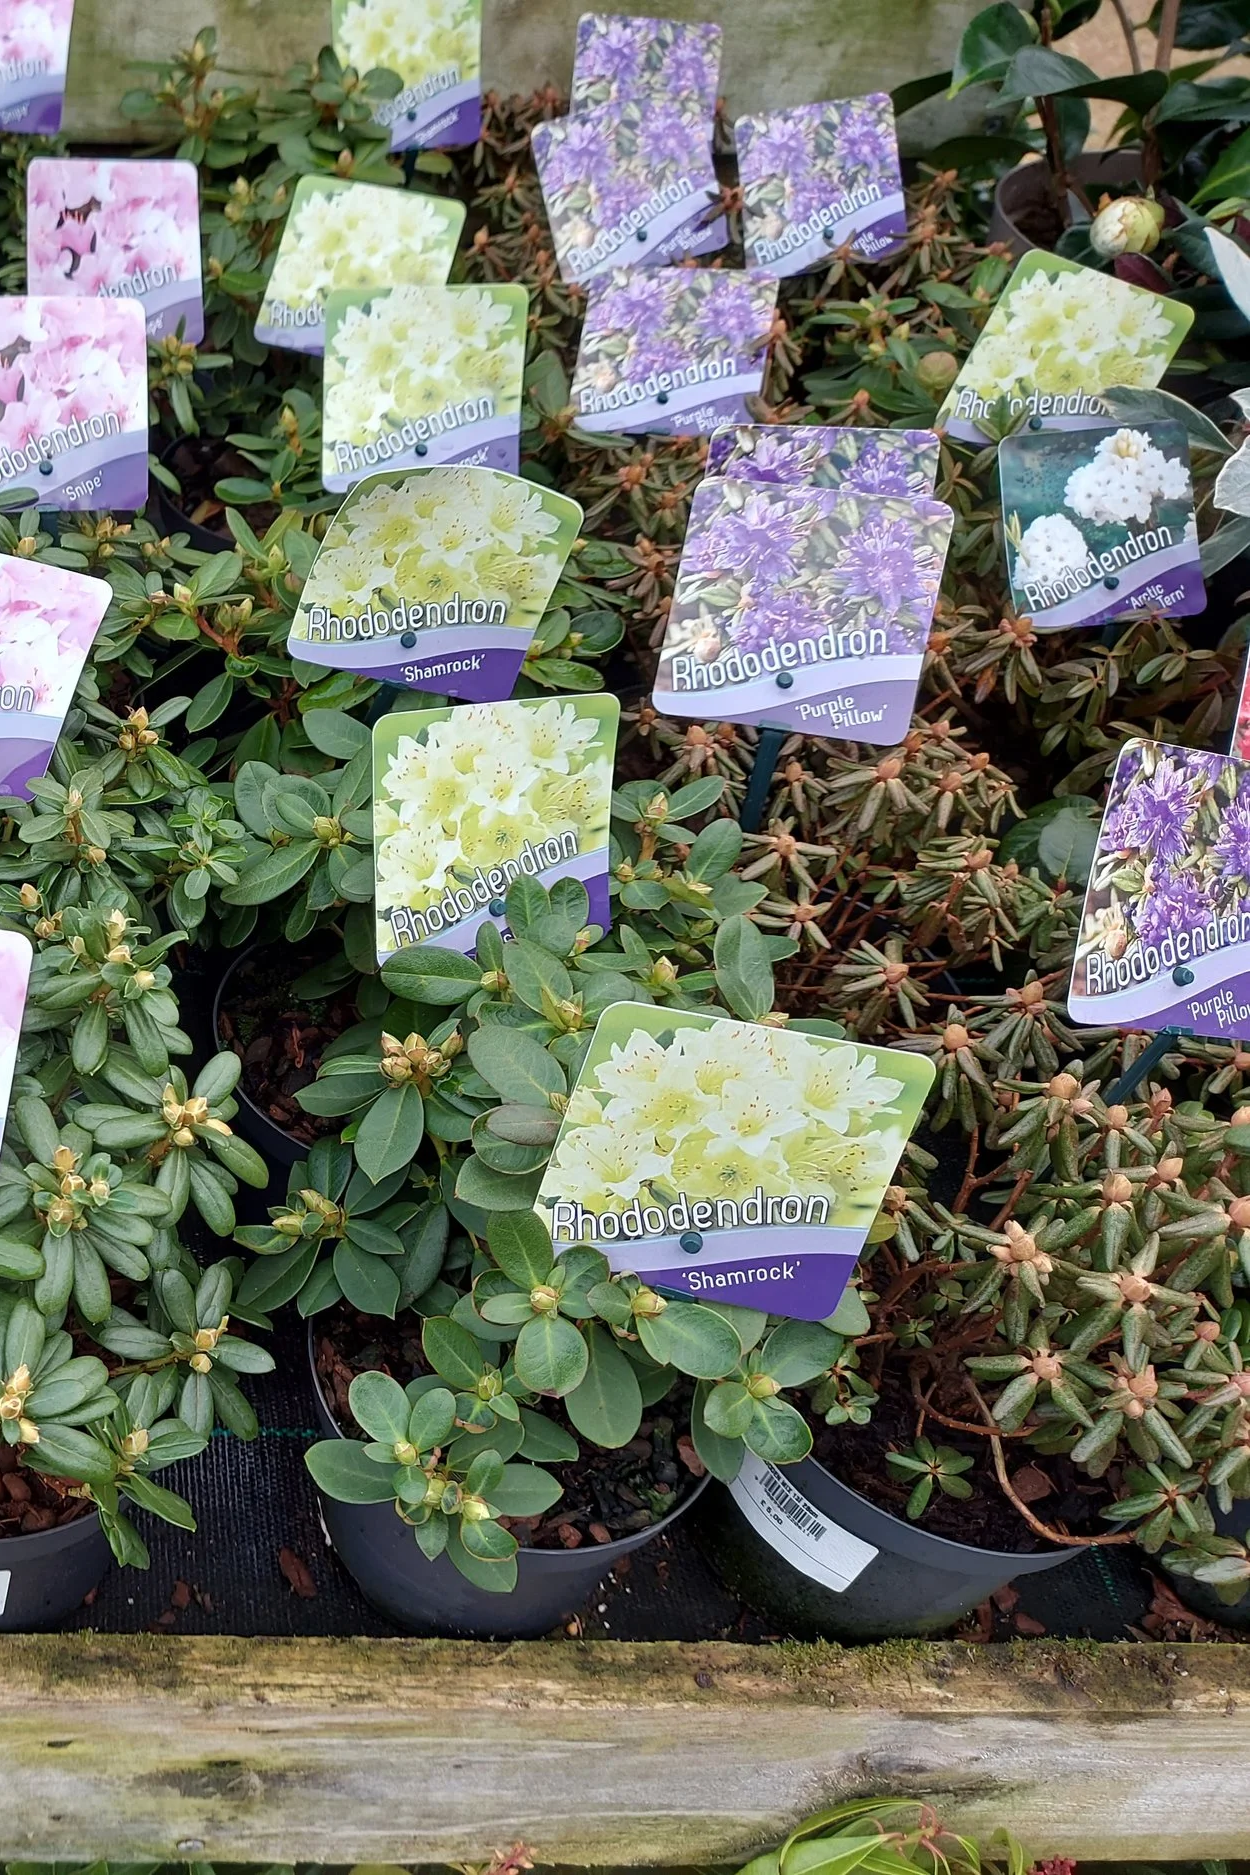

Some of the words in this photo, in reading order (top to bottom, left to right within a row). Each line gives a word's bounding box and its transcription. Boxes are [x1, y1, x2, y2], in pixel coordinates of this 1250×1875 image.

[567, 176, 694, 275] Rhododendron
[753, 183, 882, 265] Rhododendron
[97, 264, 178, 299] dendron
[579, 356, 736, 414] Rhododendron
[670, 405, 716, 429] 'Purple
[332, 396, 495, 474] Rhododendron
[62, 470, 103, 501] 'Snipe'
[1023, 526, 1173, 611] Rhododendron
[1125, 583, 1164, 610] 'Arctic
[1155, 584, 1185, 608] Tern'
[307, 591, 507, 641] Rhododendron
[400, 654, 486, 683] 'Shamrock'
[672, 625, 888, 692] Rhododendron
[795, 694, 855, 721] 'Purple
[833, 704, 889, 730] Pillow'
[389, 829, 579, 948] Rhododendron
[1187, 988, 1234, 1021] 'Purple
[1217, 1003, 1250, 1029] Pillo
[551, 1185, 830, 1241] Rhododendron
[682, 1260, 802, 1291] 'Shamrock'
